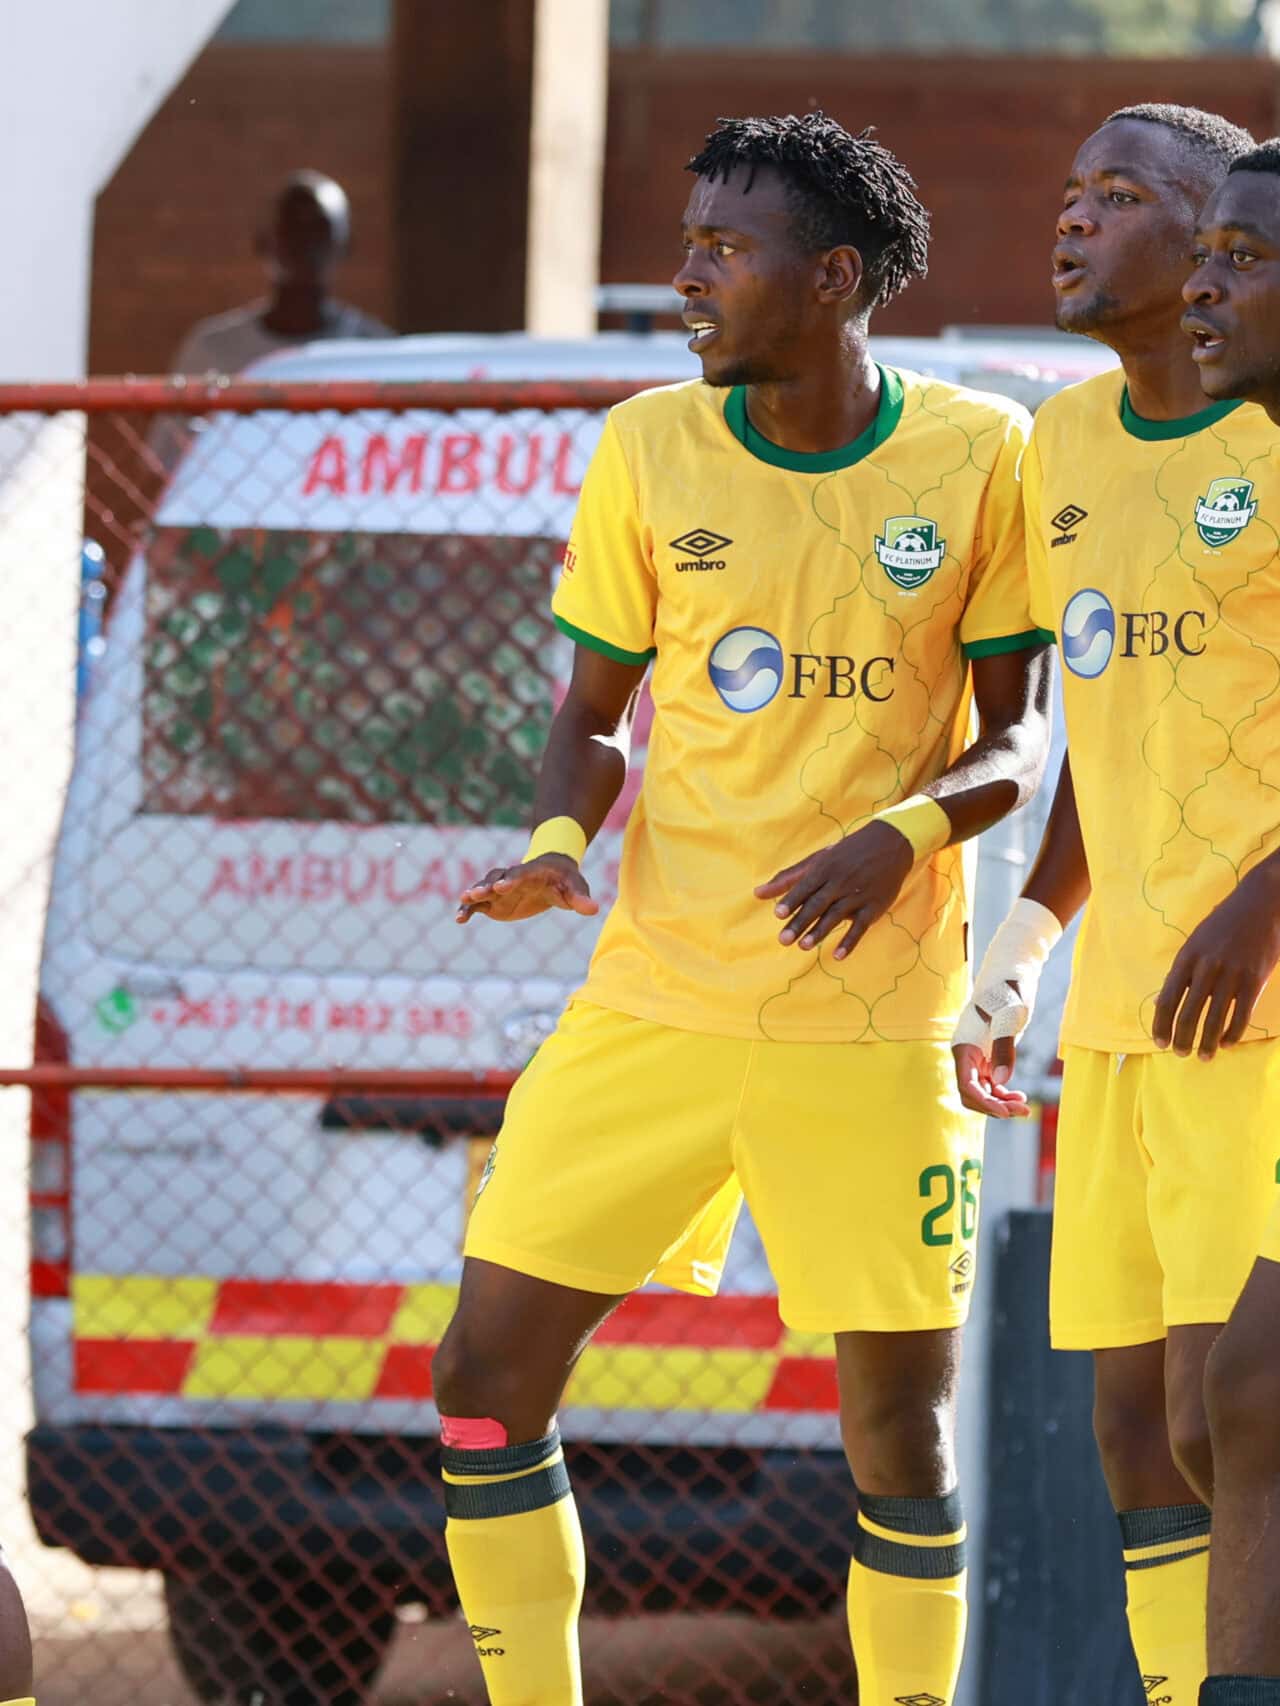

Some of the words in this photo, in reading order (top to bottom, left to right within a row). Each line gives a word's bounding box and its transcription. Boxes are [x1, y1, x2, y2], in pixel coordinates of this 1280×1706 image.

[675, 558, 726, 572] umbro
[896, 556, 932, 565] PLATINUM
[1120, 610, 1207, 658] FBC
[788, 653, 896, 701] FBC
[919, 1159, 982, 1247] 26
